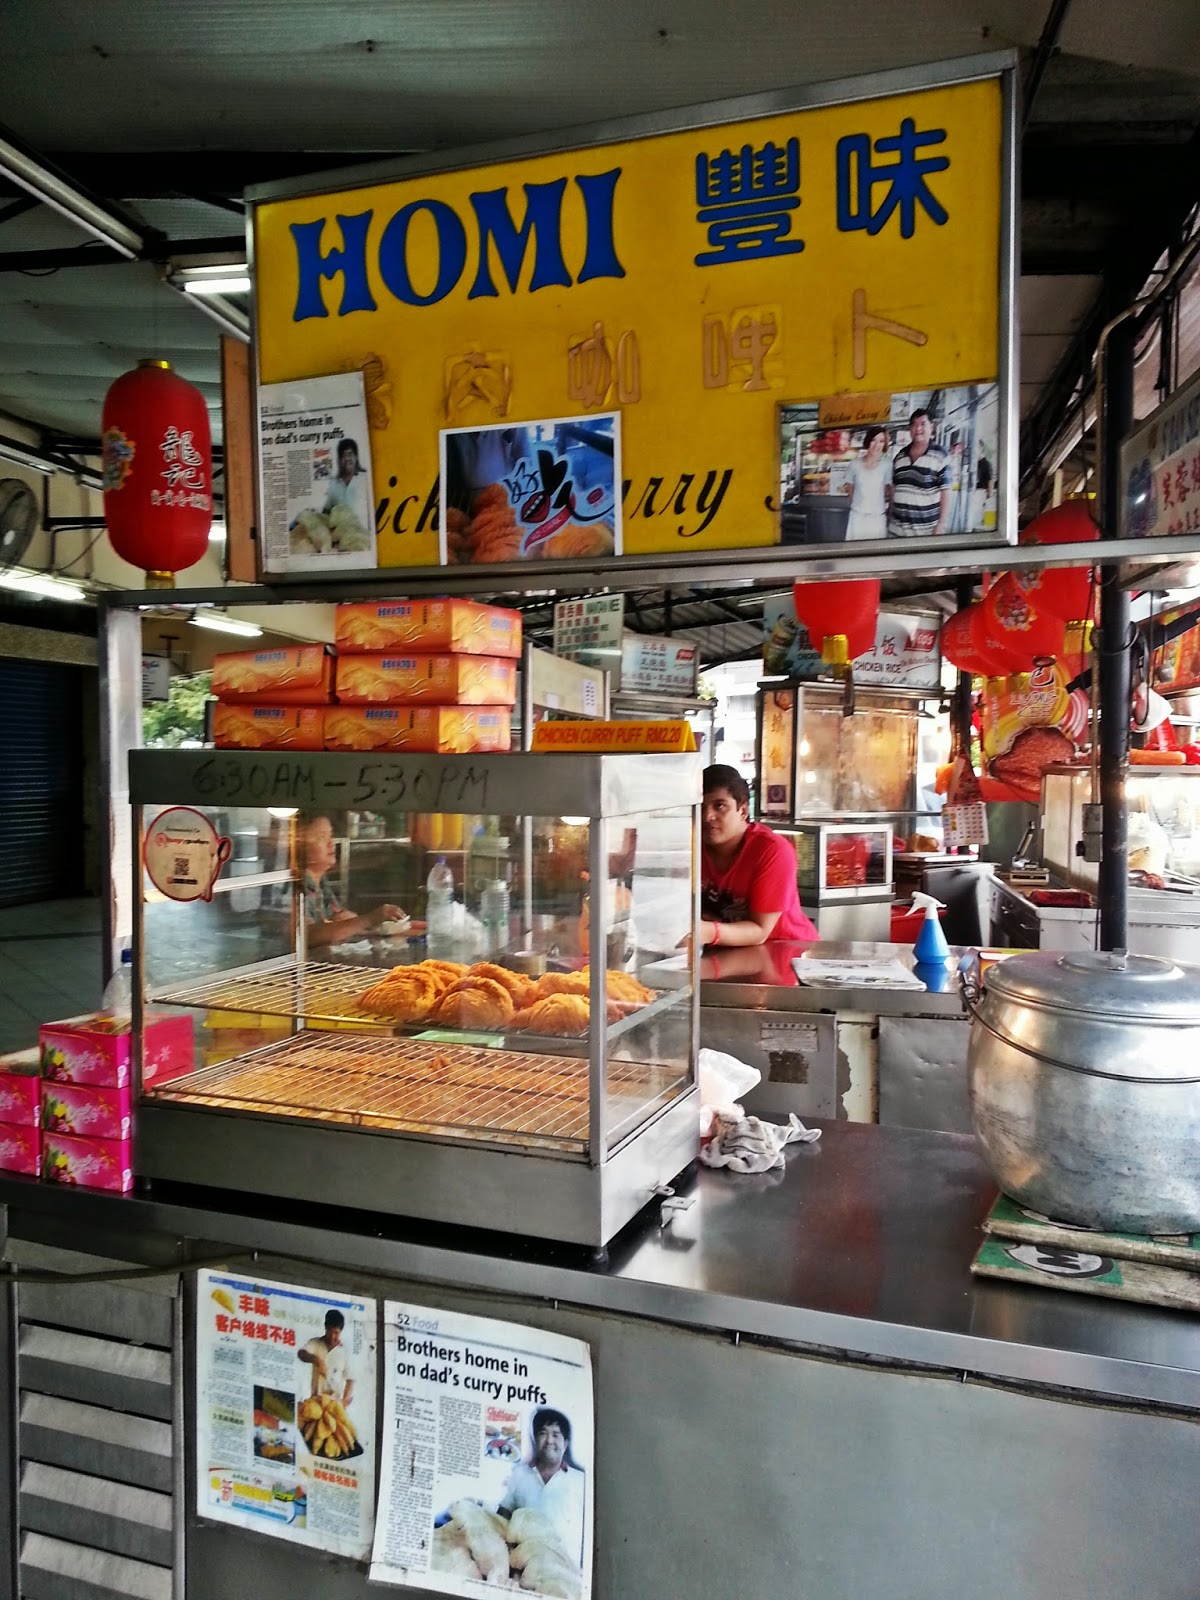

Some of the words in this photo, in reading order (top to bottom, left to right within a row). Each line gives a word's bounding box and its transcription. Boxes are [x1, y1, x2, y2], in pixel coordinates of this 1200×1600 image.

[694, 116, 951, 267] 豐味
[289, 166, 626, 322] HOMI
[261, 419, 298, 432] Brothers
[299, 416, 323, 428] home
[324, 413, 334, 426] in
[274, 432, 298, 445] dad's
[299, 433, 321, 445] curry
[322, 427, 345, 443] puffs
[853, 661, 884, 673] CHICKEN
[885, 661, 901, 674] RICE
[537, 728, 579, 744] CHICKEN
[581, 728, 615, 744] CURRY
[617, 727, 644, 743] PUFF
[645, 727, 682, 743] RM2.20
[397, 1313, 411, 1326] 52
[412, 1315, 440, 1331] Food
[397, 1335, 460, 1363] Brothers
[465, 1348, 509, 1372] home
[514, 1357, 528, 1377] in
[397, 1362, 415, 1377] on
[420, 1362, 460, 1386] dad's
[464, 1376, 503, 1400] curry
[507, 1384, 547, 1405] puffs
